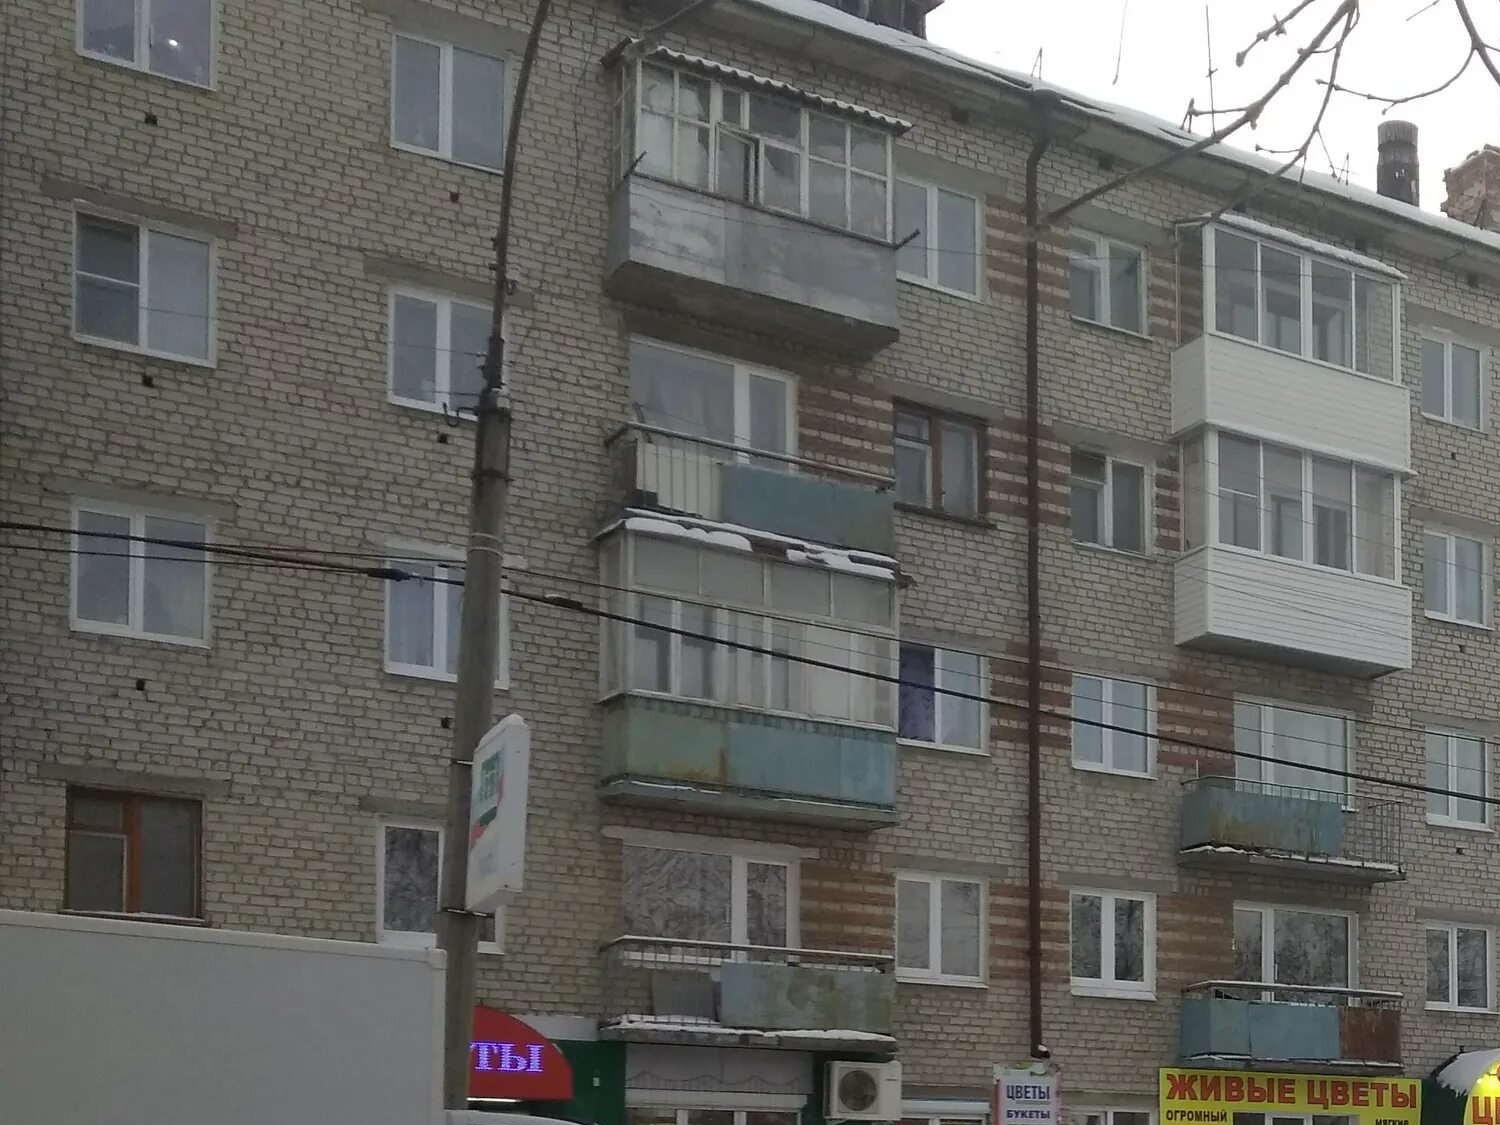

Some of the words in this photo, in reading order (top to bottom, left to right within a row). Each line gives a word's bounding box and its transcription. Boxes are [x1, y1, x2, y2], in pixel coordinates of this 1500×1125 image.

[470, 1041, 545, 1073] ТЫ
[1006, 1085, 1050, 1100] ЦВЕТЫ
[1166, 1074, 1296, 1104] ЖИВЫЕ
[1307, 1079, 1417, 1110] ЦВЕТЫ
[1007, 1110, 1050, 1119] БУКЕТЫ
[1166, 1109, 1228, 1122] ОГРОМНЫЙ
